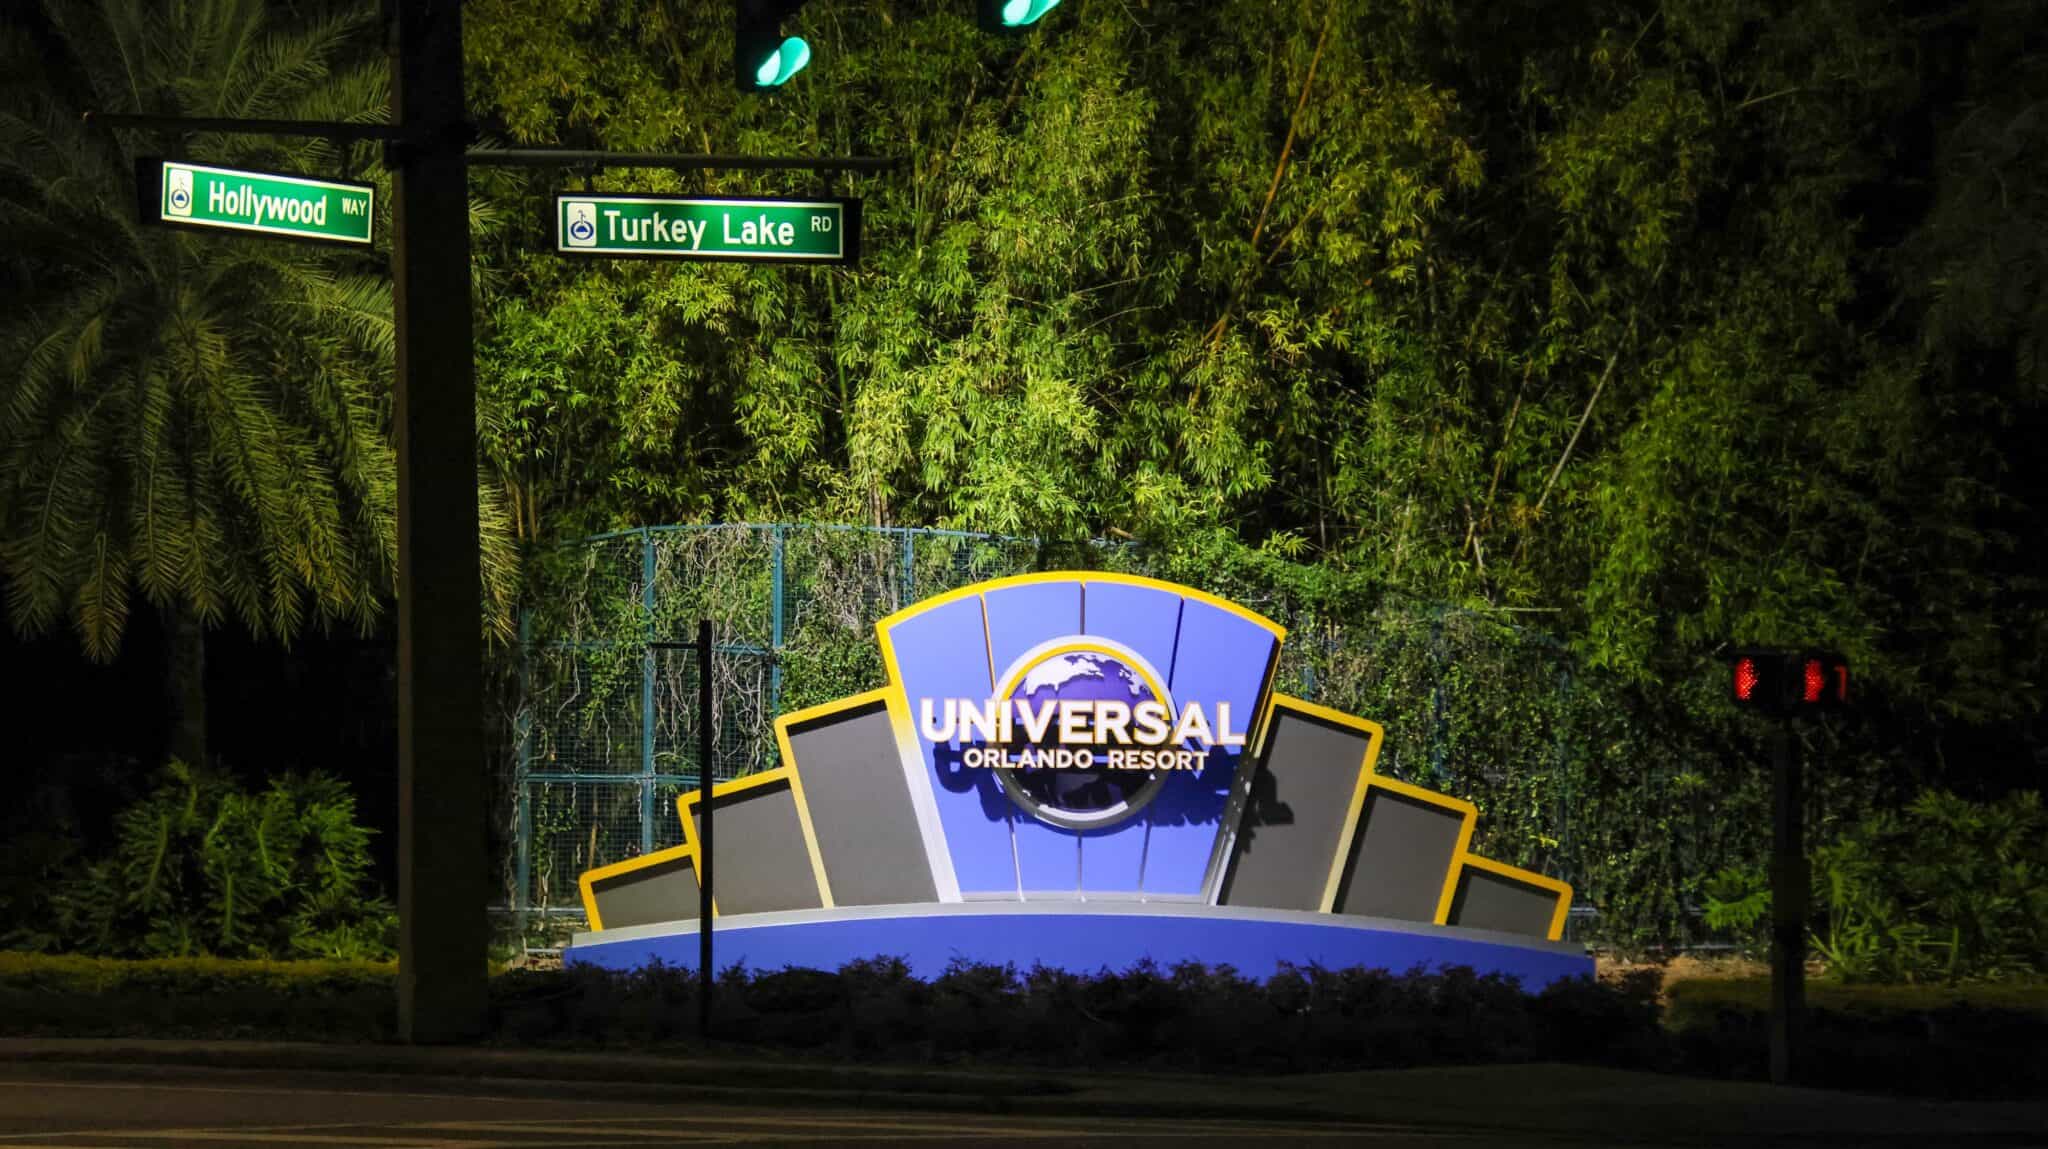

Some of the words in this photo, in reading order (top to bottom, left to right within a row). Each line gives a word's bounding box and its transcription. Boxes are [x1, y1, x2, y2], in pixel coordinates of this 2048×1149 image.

[208, 180, 327, 226] Hollywood
[342, 197, 367, 216] WAY
[603, 209, 707, 251] Turkey
[722, 213, 795, 246] Lake
[811, 215, 832, 233] RD
[920, 698, 1247, 746] UNIVERSAL
[963, 748, 1093, 769] ORLANDO
[1107, 749, 1209, 771] RESORT
